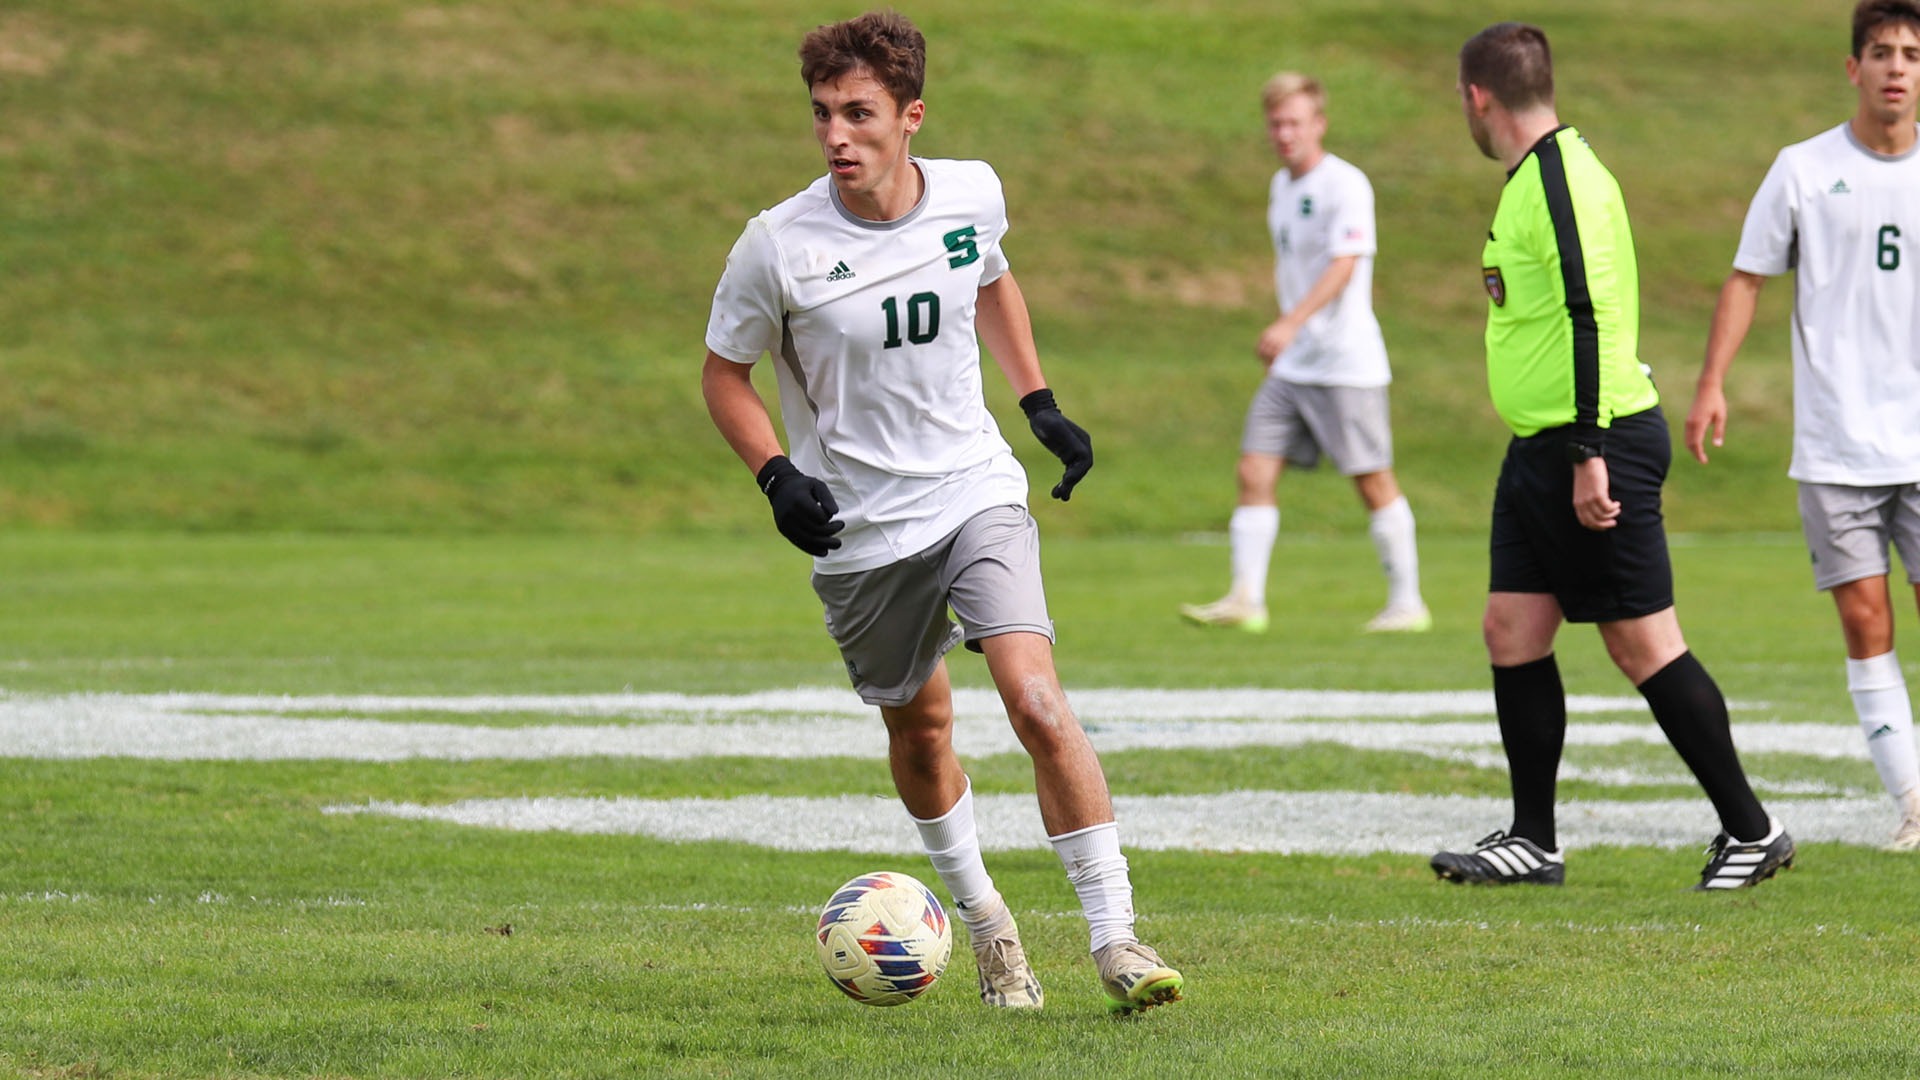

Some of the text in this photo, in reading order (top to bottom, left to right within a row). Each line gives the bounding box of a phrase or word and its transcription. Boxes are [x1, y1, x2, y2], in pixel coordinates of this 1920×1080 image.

[943, 224, 979, 269] S
[1877, 224, 1901, 271] 6
[826, 271, 856, 282] adidas
[881, 291, 940, 349] 10
